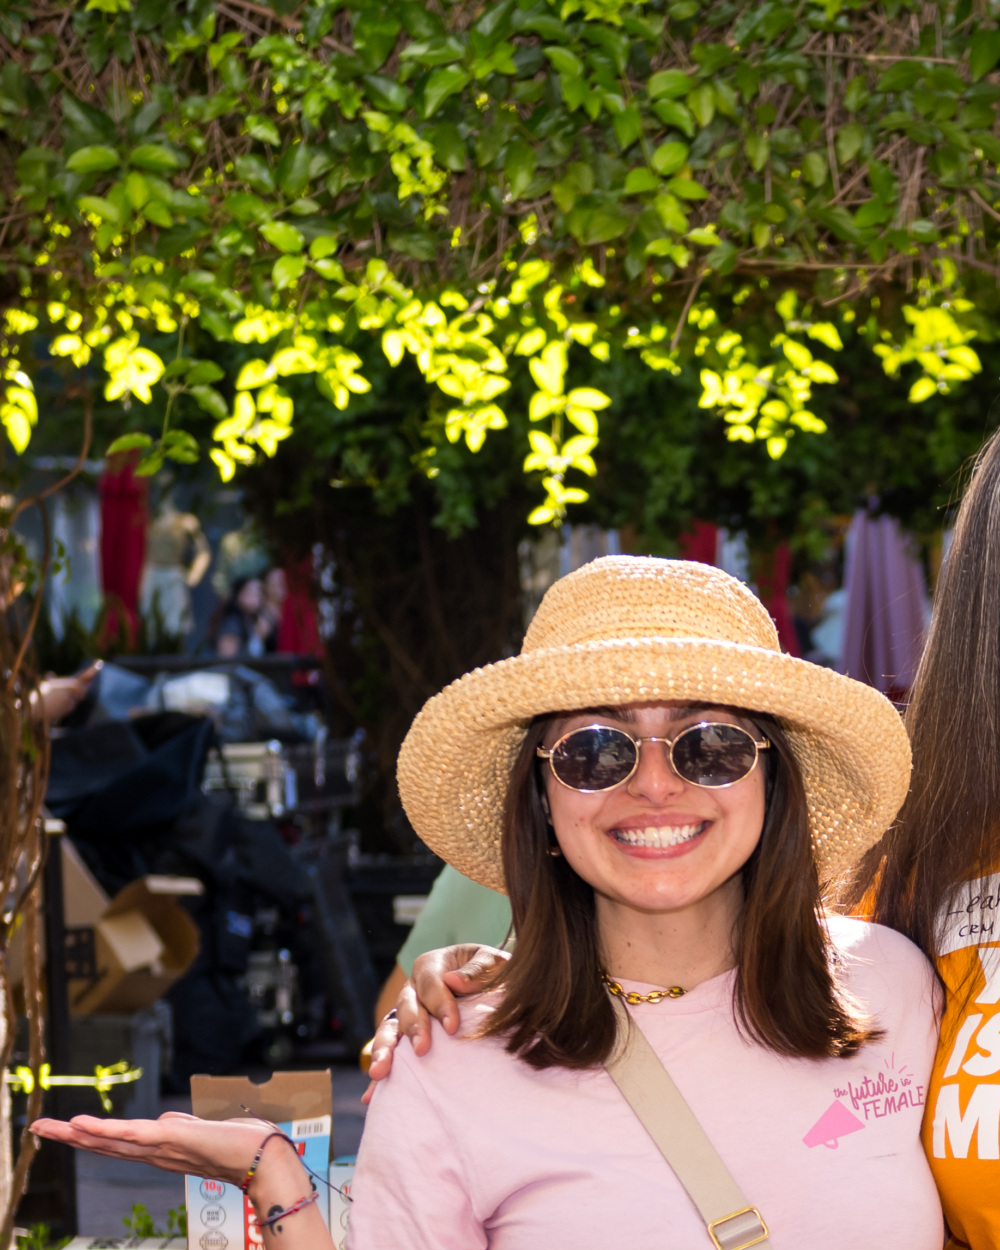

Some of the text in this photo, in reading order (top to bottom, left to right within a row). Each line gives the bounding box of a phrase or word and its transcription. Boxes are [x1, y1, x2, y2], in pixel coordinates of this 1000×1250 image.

[833, 1072, 911, 1110] the future is
[862, 1086, 925, 1120] FEMALE
